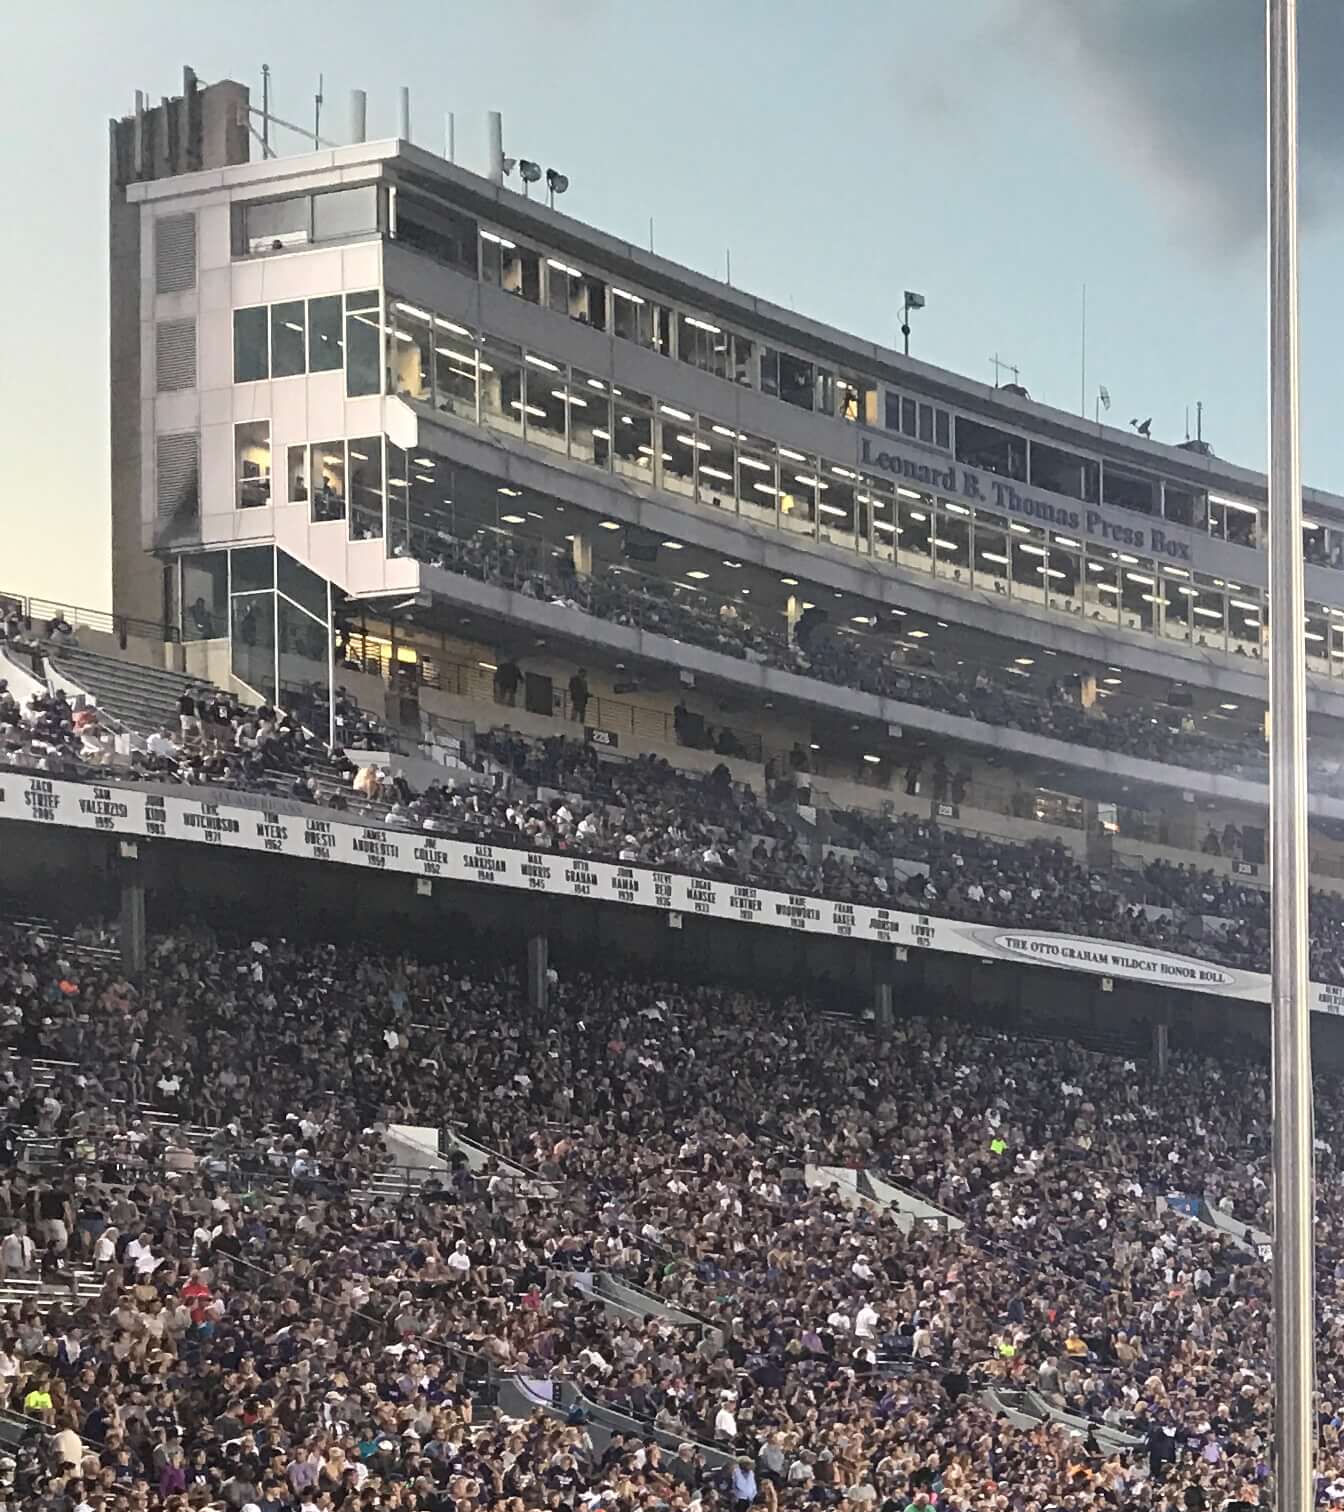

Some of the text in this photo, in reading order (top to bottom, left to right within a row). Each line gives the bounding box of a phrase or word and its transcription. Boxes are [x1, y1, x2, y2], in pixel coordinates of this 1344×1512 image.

[861, 436, 1193, 560] Leonard B. Thomas Press Box
[1005, 937, 1226, 983] THE OTTO GRAHAM WILDCAT HONOR ROLL
